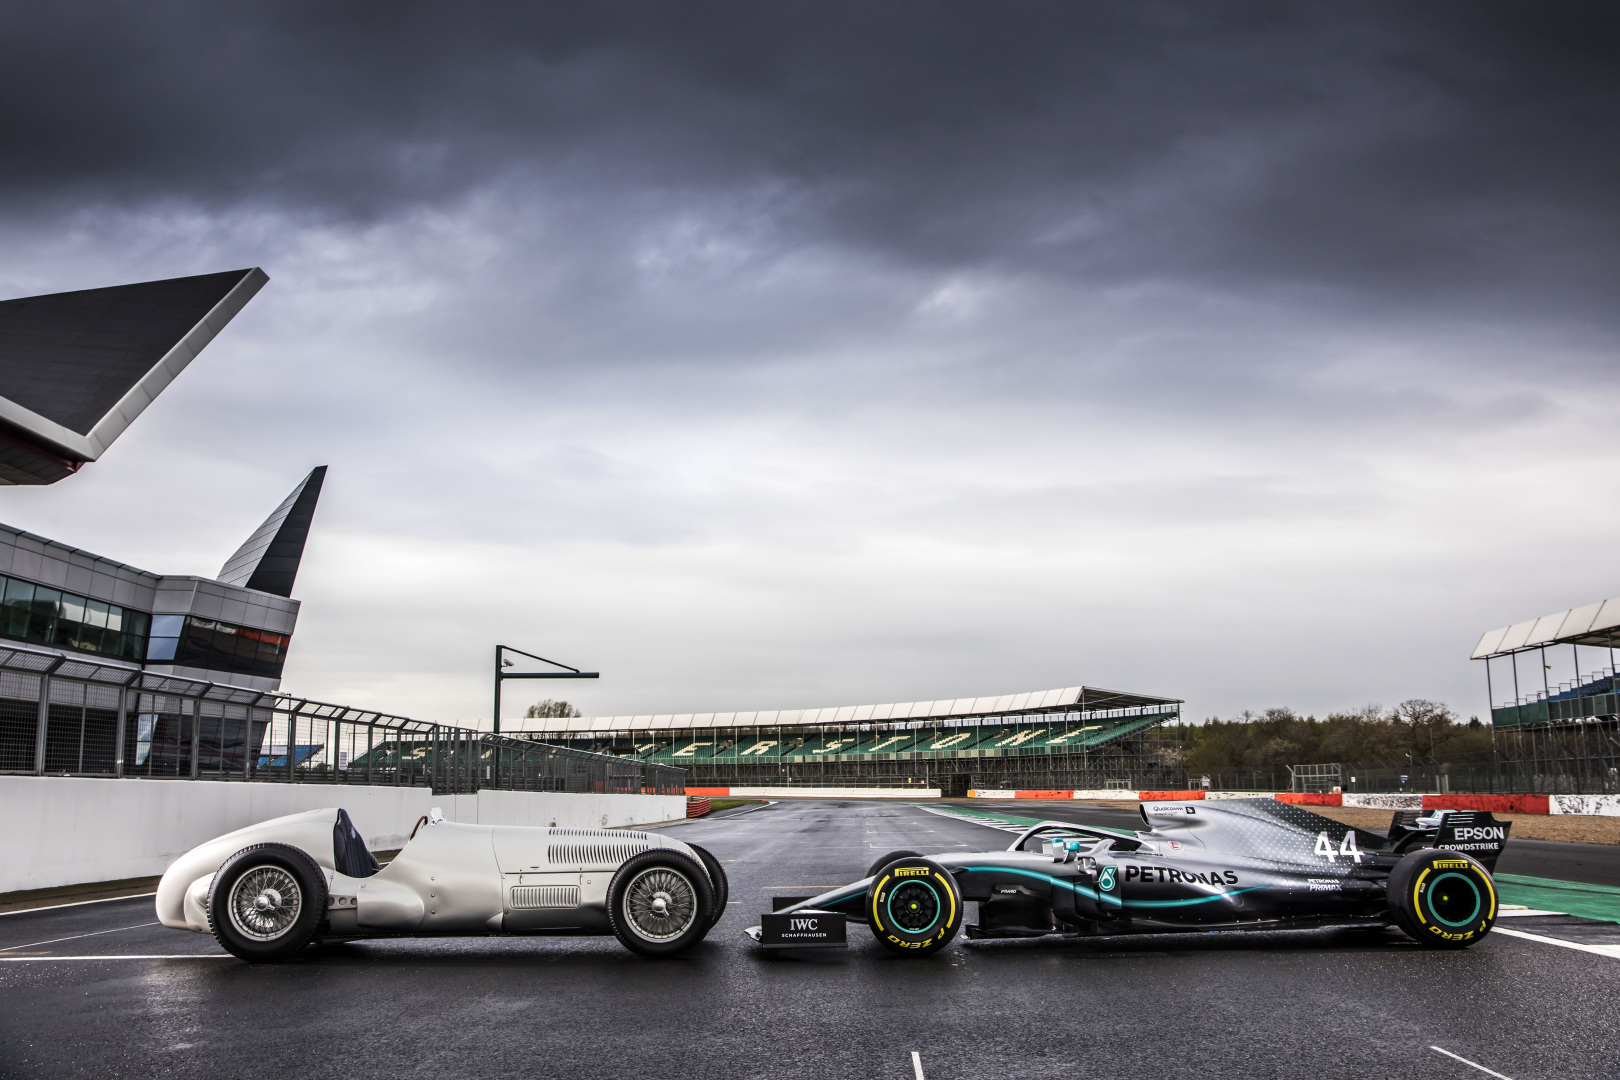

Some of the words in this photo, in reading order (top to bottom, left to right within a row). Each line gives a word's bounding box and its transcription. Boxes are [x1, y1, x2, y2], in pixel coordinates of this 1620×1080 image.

[1454, 826, 1504, 840] EPSON
[1314, 830, 1366, 863] 44
[1439, 842, 1499, 851] CROWDSTRIKE
[1432, 860, 1468, 869] PIRELLI
[894, 867, 930, 877] PIRELLI
[1124, 865, 1239, 886] PETRONAS
[789, 918, 818, 931] IWC
[1428, 926, 1475, 941] ZERO
[887, 934, 933, 949] ZERO
